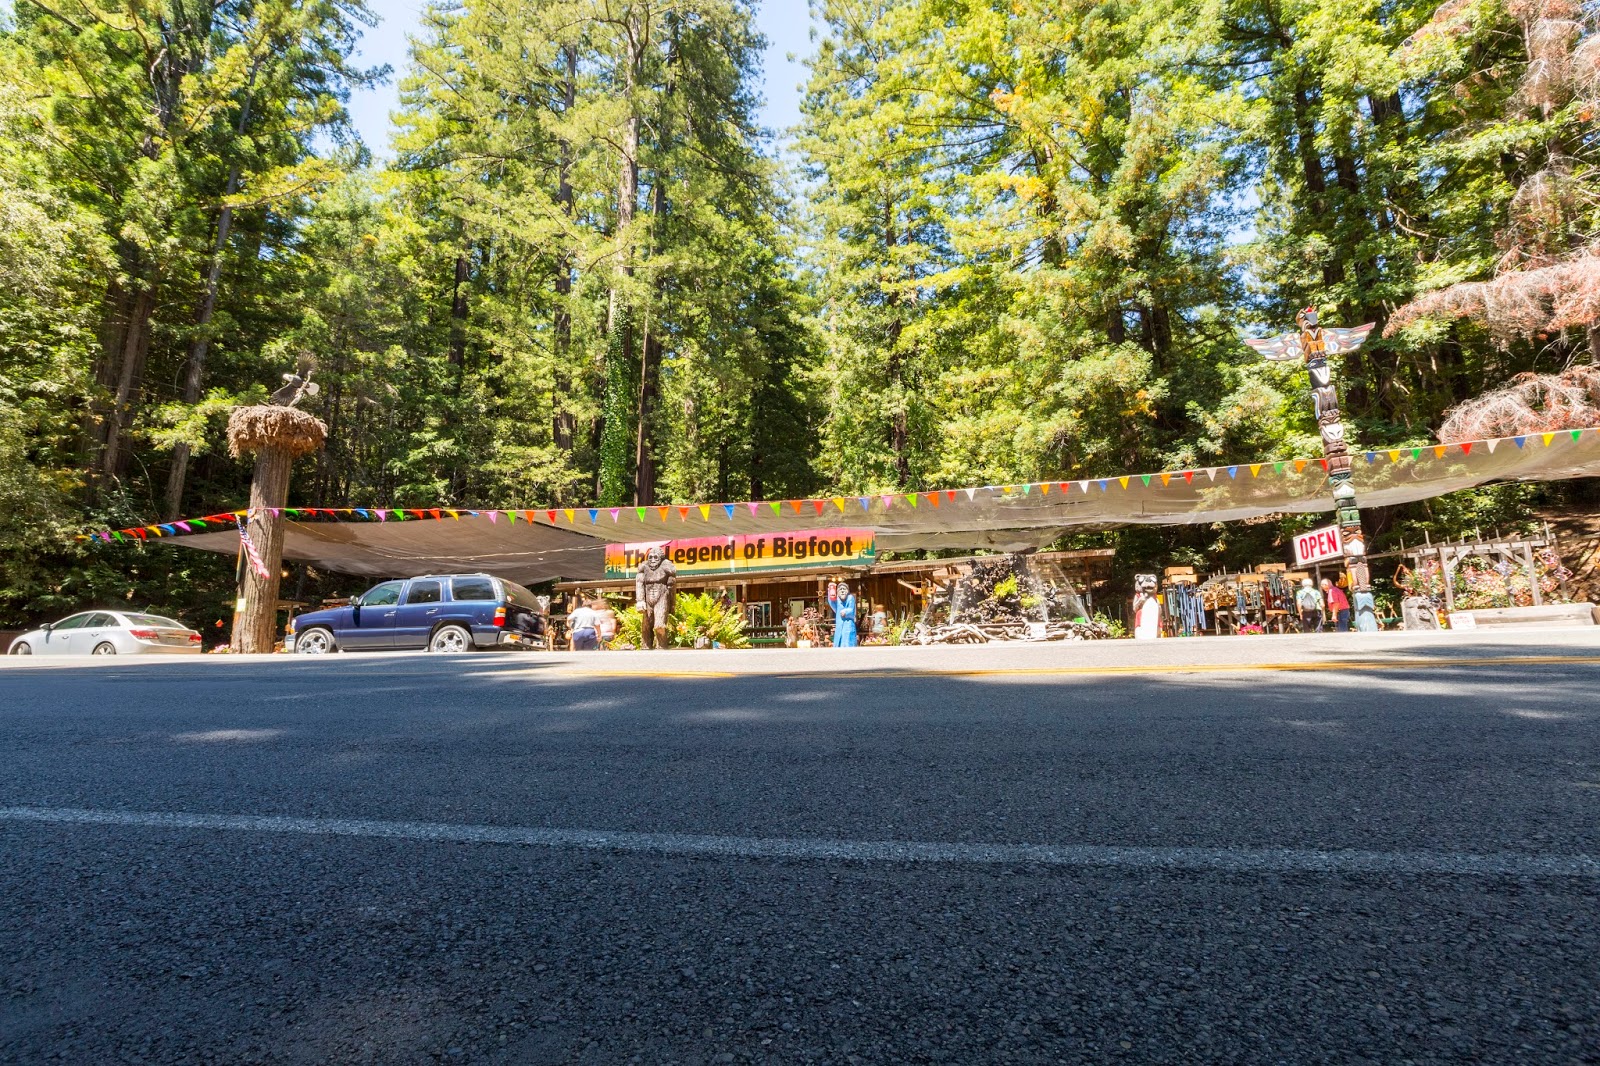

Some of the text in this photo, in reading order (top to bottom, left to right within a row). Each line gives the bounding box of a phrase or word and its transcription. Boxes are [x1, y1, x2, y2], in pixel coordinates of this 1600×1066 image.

[624, 536, 852, 568] Th Legend of Bigfoot
[1299, 530, 1338, 560] OPEN
